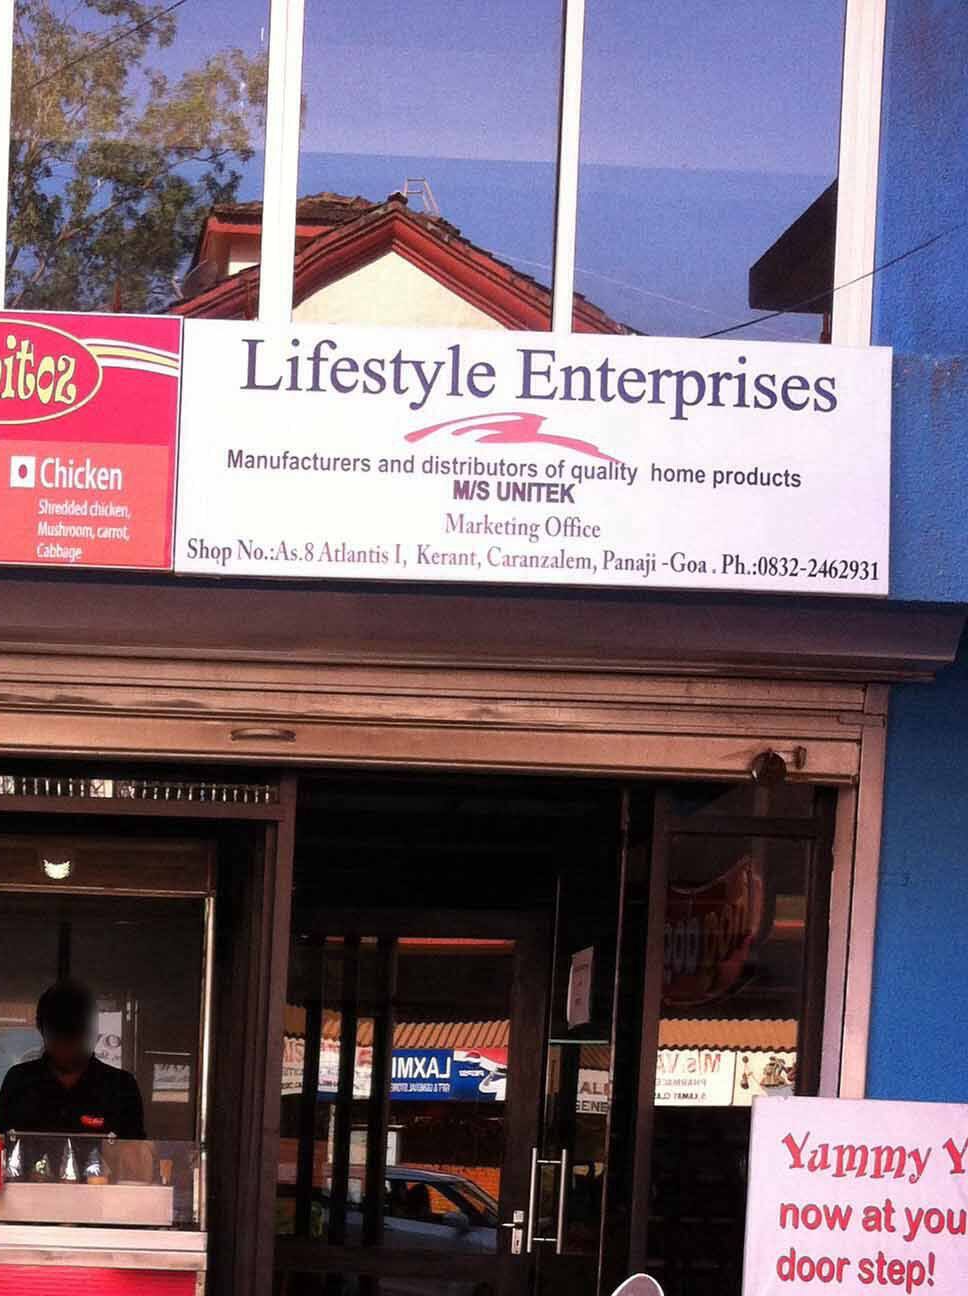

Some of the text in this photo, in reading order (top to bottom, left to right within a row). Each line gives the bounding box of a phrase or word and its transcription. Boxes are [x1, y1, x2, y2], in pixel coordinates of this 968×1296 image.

[240, 338, 838, 420] Lifestyle Enterprises
[39, 457, 123, 491] Chicken
[227, 449, 802, 488] Manufacturers and distributors of quality home products
[38, 499, 88, 516] Shredded
[453, 480, 576, 504] M/S UNITEK
[445, 513, 601, 542] Marketing Office
[36, 543, 83, 562] Cabbage
[187, 537, 232, 567] Shop
[317, 541, 389, 564] Atlantis
[417, 544, 482, 569] Kerant,
[487, 545, 598, 574] Caranzalem,
[602, 550, 657, 578] Panaji
[782, 1131, 932, 1184] Yummy
[779, 1202, 853, 1231] now
[861, 1198, 896, 1233] at
[776, 1247, 936, 1295] door step!
